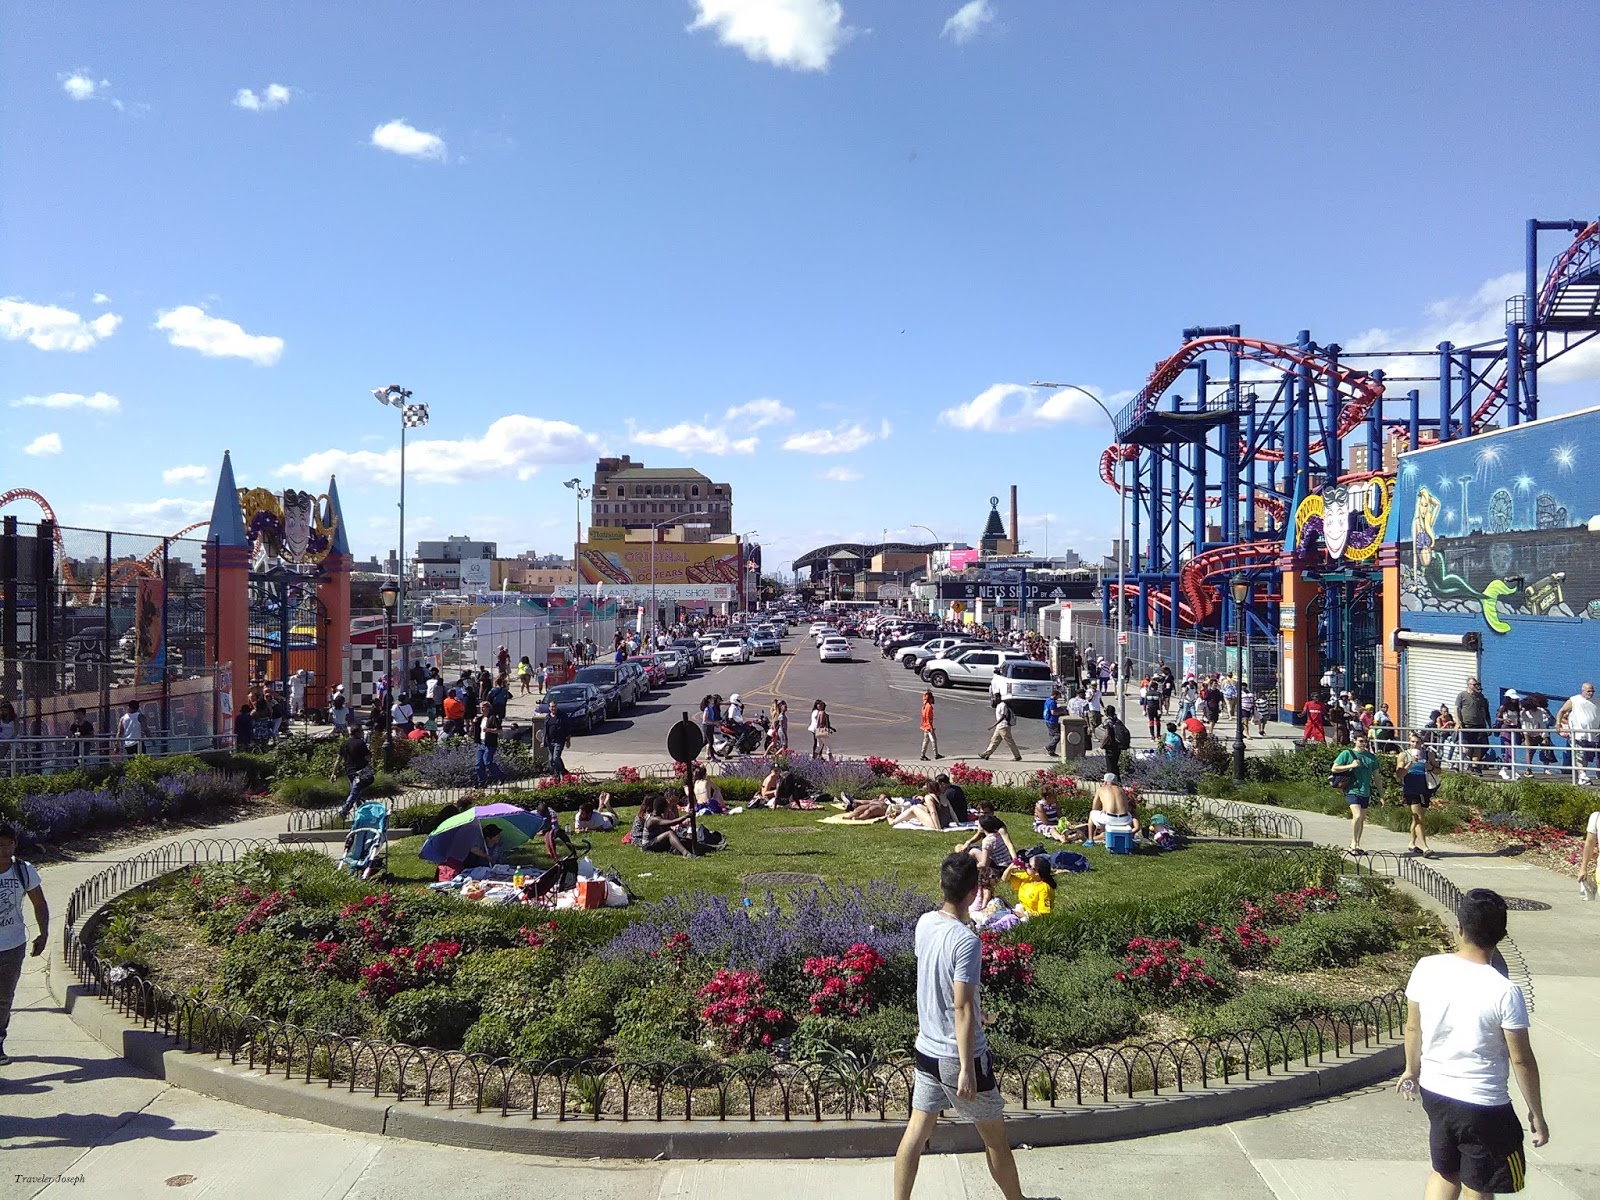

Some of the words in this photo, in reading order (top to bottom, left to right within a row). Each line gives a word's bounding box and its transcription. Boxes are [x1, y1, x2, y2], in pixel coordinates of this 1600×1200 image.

[653, 569, 684, 579] YEARS
[685, 588, 710, 598] SHOP
[979, 585, 1006, 598] NETS
